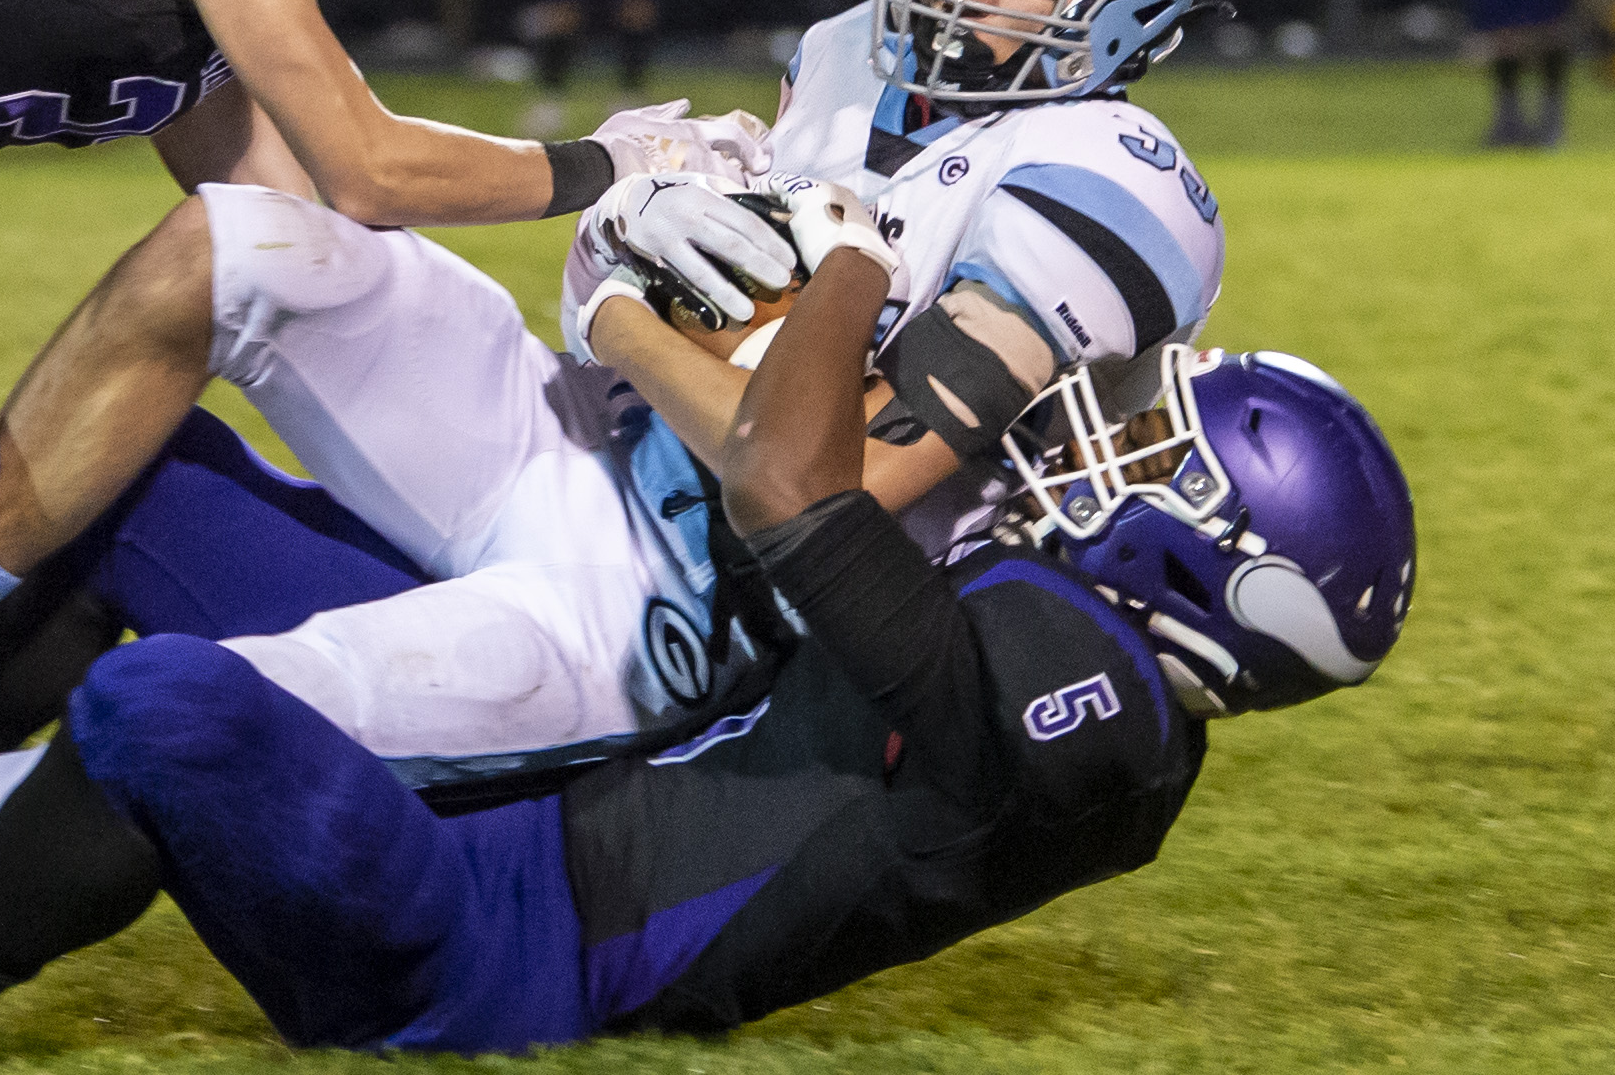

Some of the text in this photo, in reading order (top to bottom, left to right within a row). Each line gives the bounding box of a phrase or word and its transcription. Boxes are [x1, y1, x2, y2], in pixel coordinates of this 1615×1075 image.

[939, 156, 969, 186] G
[1055, 301, 1092, 349] Riddell
[643, 597, 711, 705] G
[1022, 672, 1122, 742] 5
